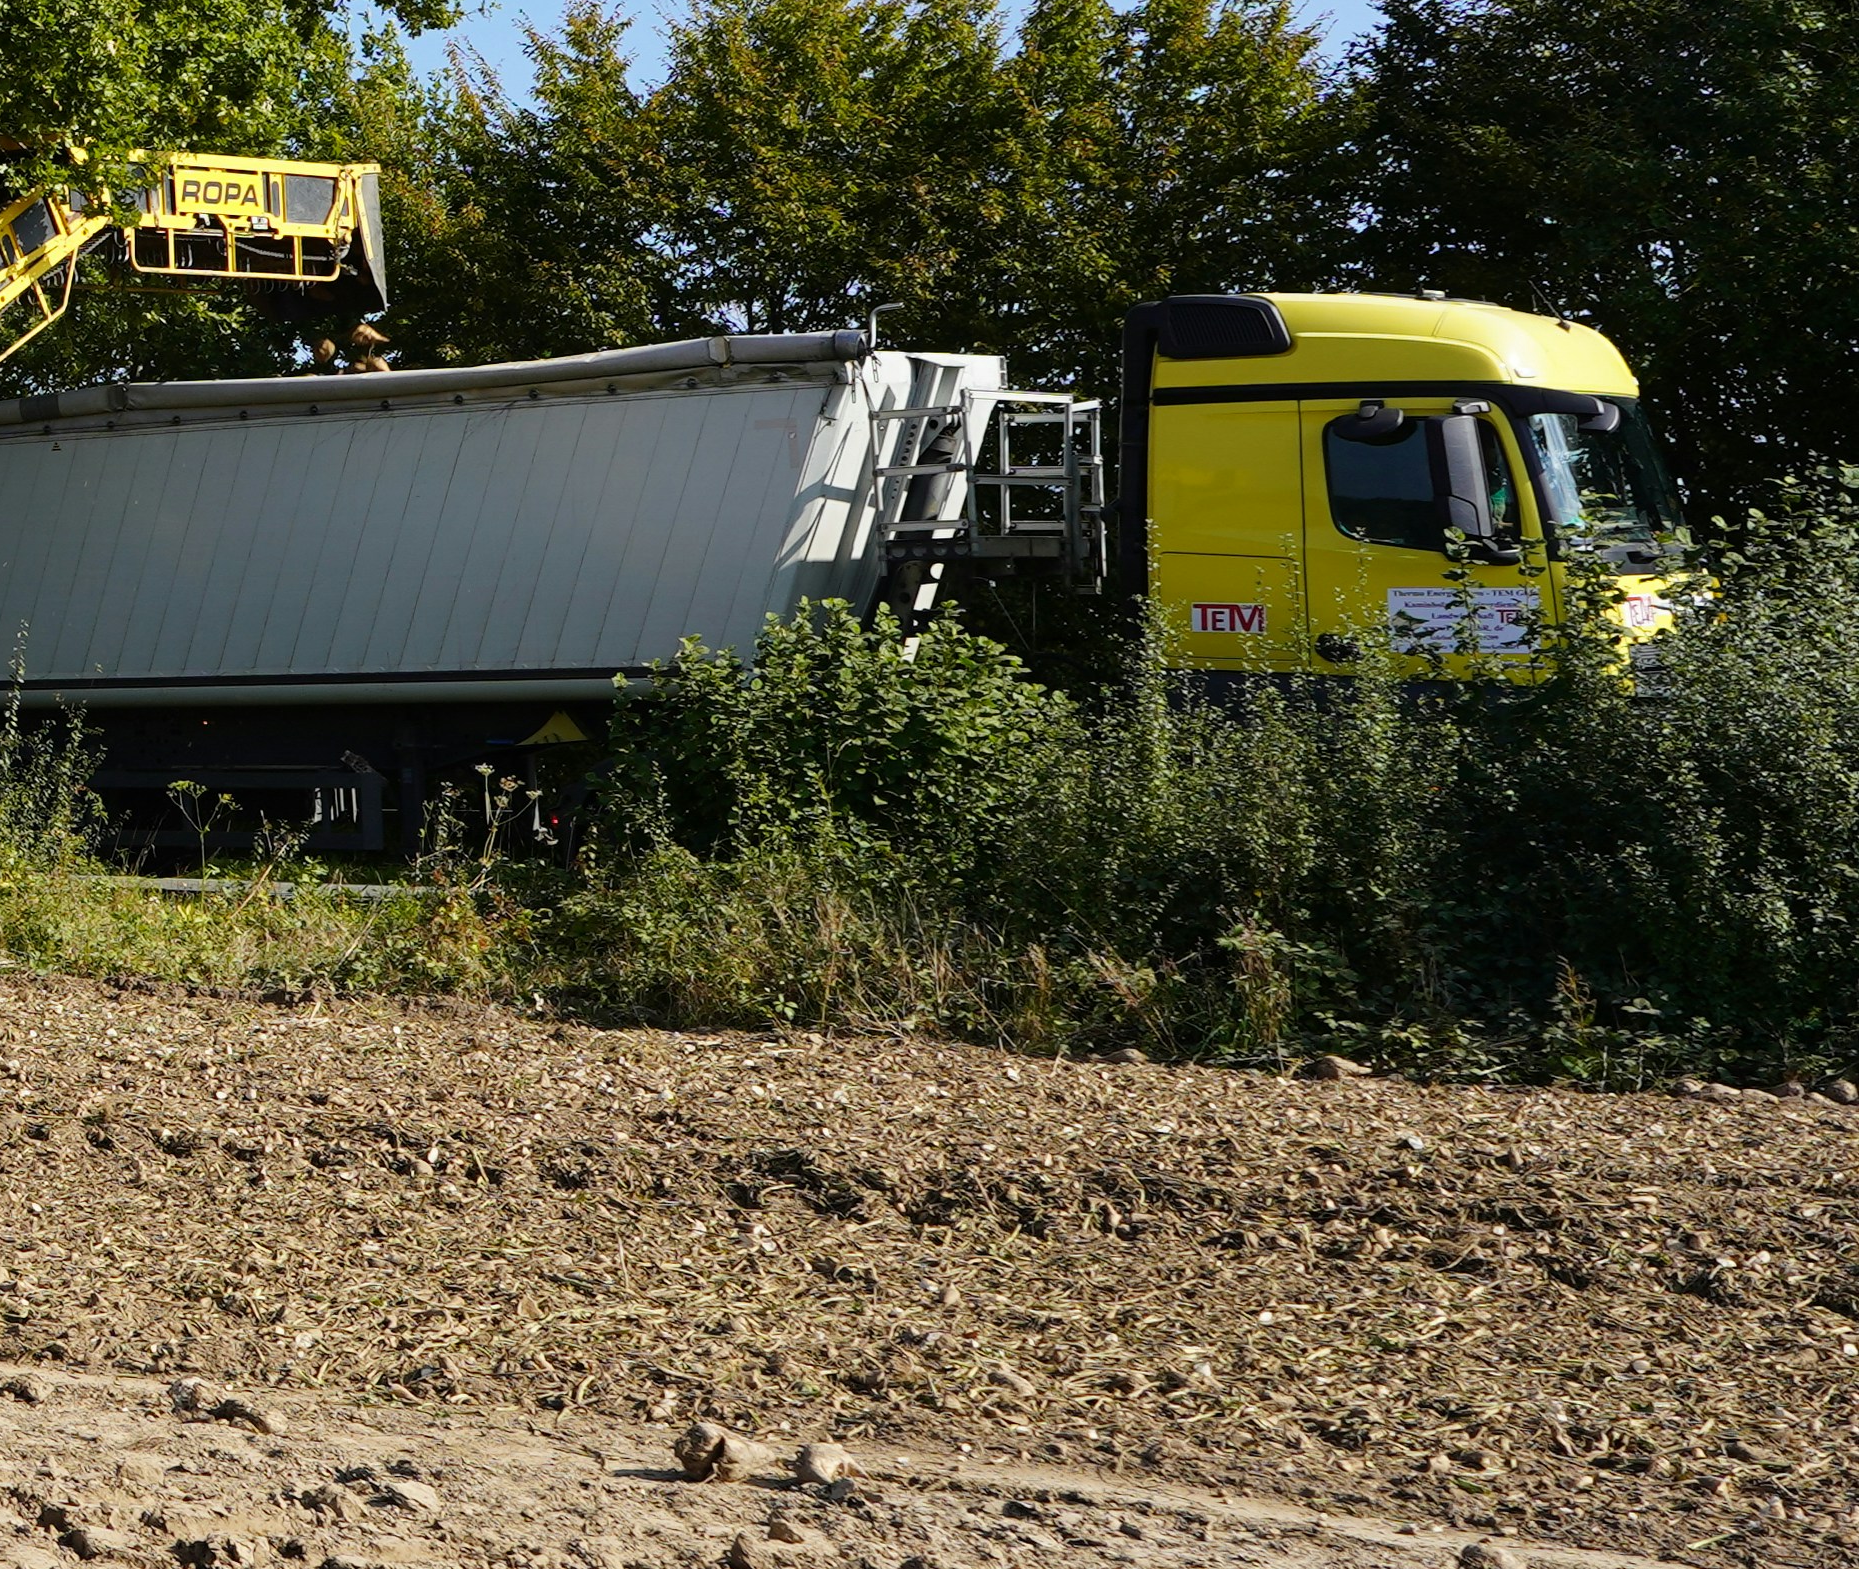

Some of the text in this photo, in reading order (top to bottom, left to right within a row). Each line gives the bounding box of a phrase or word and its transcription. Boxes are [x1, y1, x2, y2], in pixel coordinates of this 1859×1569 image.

[181, 179, 259, 207] ROPA
[1193, 603, 1264, 632] TEM
[1496, 609, 1523, 623] TE
